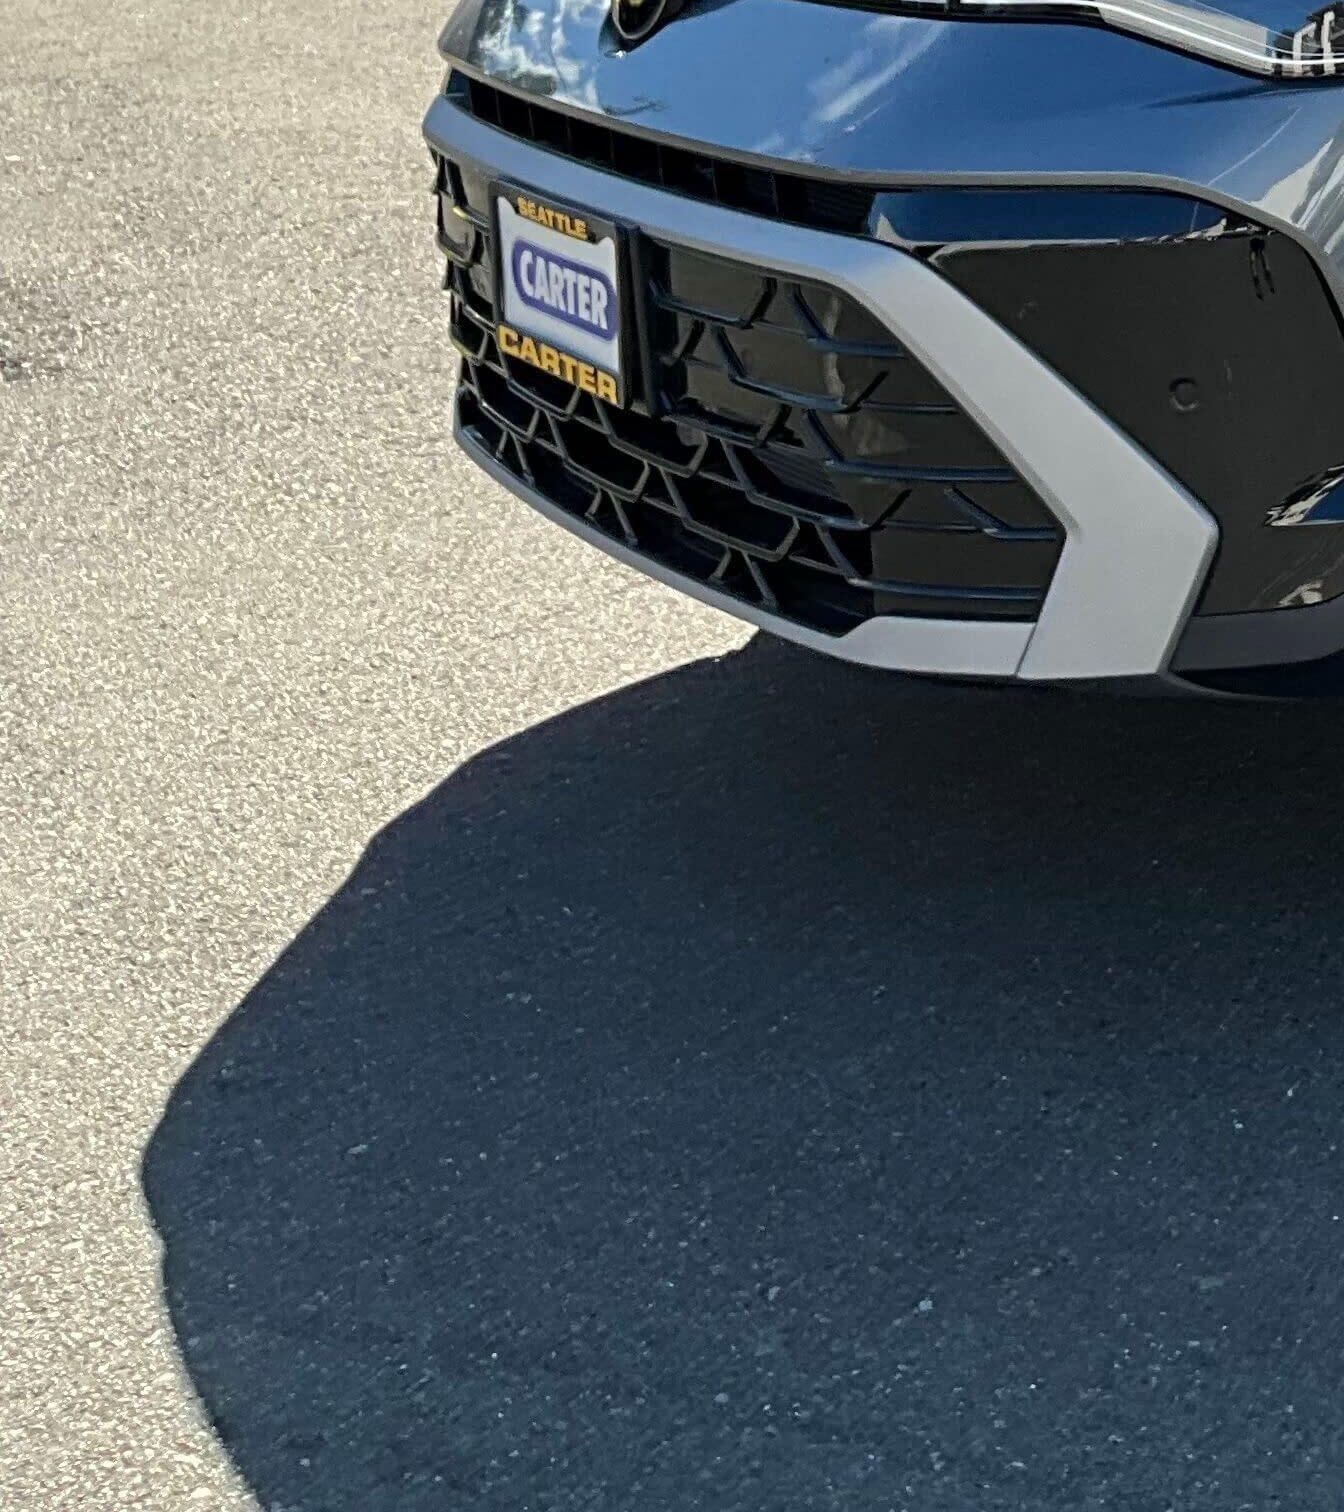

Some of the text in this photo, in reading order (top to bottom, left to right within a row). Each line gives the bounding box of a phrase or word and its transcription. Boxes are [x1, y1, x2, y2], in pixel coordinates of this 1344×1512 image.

[517, 196, 588, 240] SEATTLE
[519, 249, 609, 330] CARTER
[498, 323, 618, 405] CARTER
